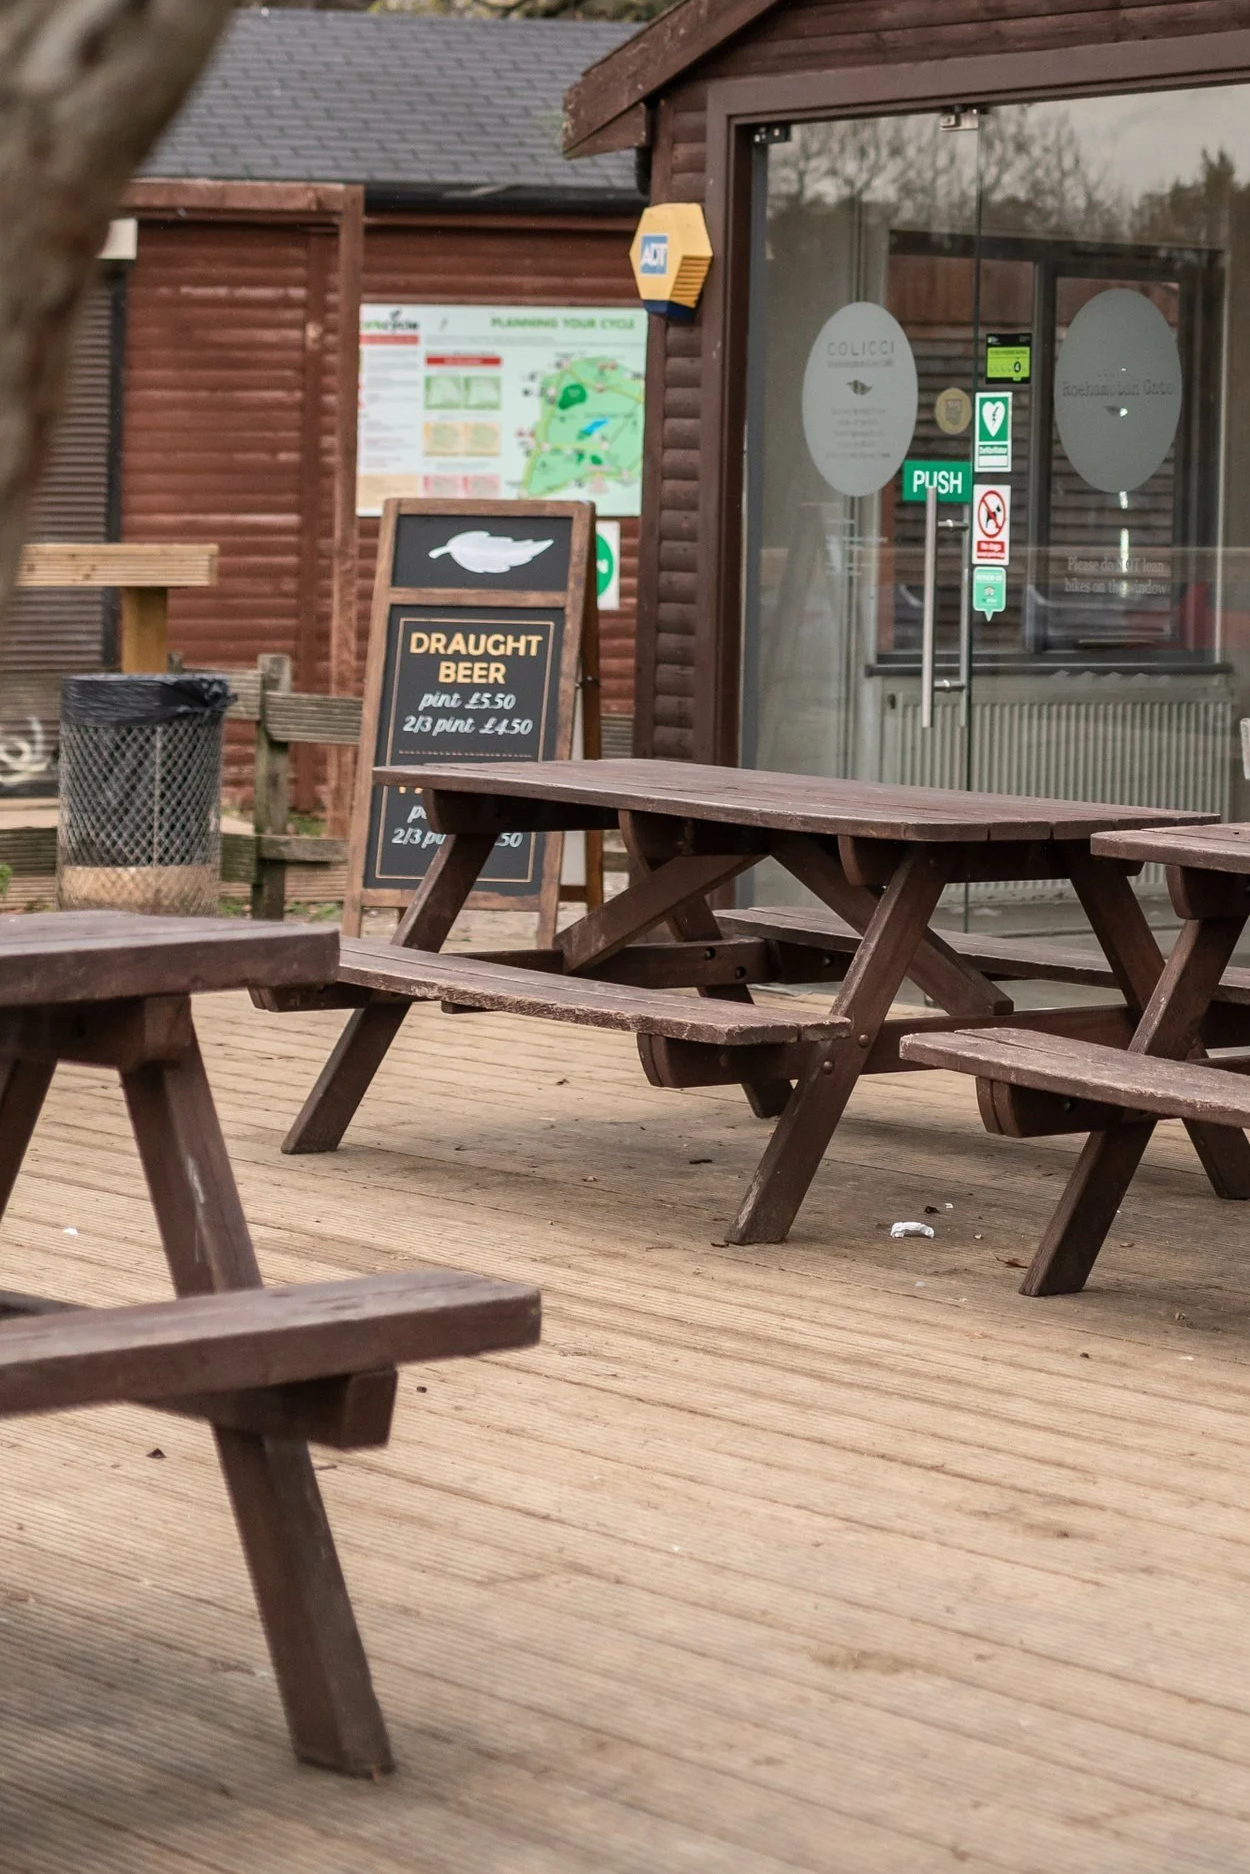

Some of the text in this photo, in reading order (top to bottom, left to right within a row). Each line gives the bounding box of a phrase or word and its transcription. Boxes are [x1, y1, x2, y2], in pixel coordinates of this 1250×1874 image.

[641, 243, 668, 267] ADT
[827, 340, 895, 356] COLICCI
[912, 470, 962, 494] PUSH
[409, 632, 543, 656] DRAUGHT
[438, 661, 507, 684] BEER
[418, 691, 463, 711] pint
[403, 714, 433, 733] 2/3
[432, 717, 476, 736] pint
[392, 827, 422, 845] 2/3
